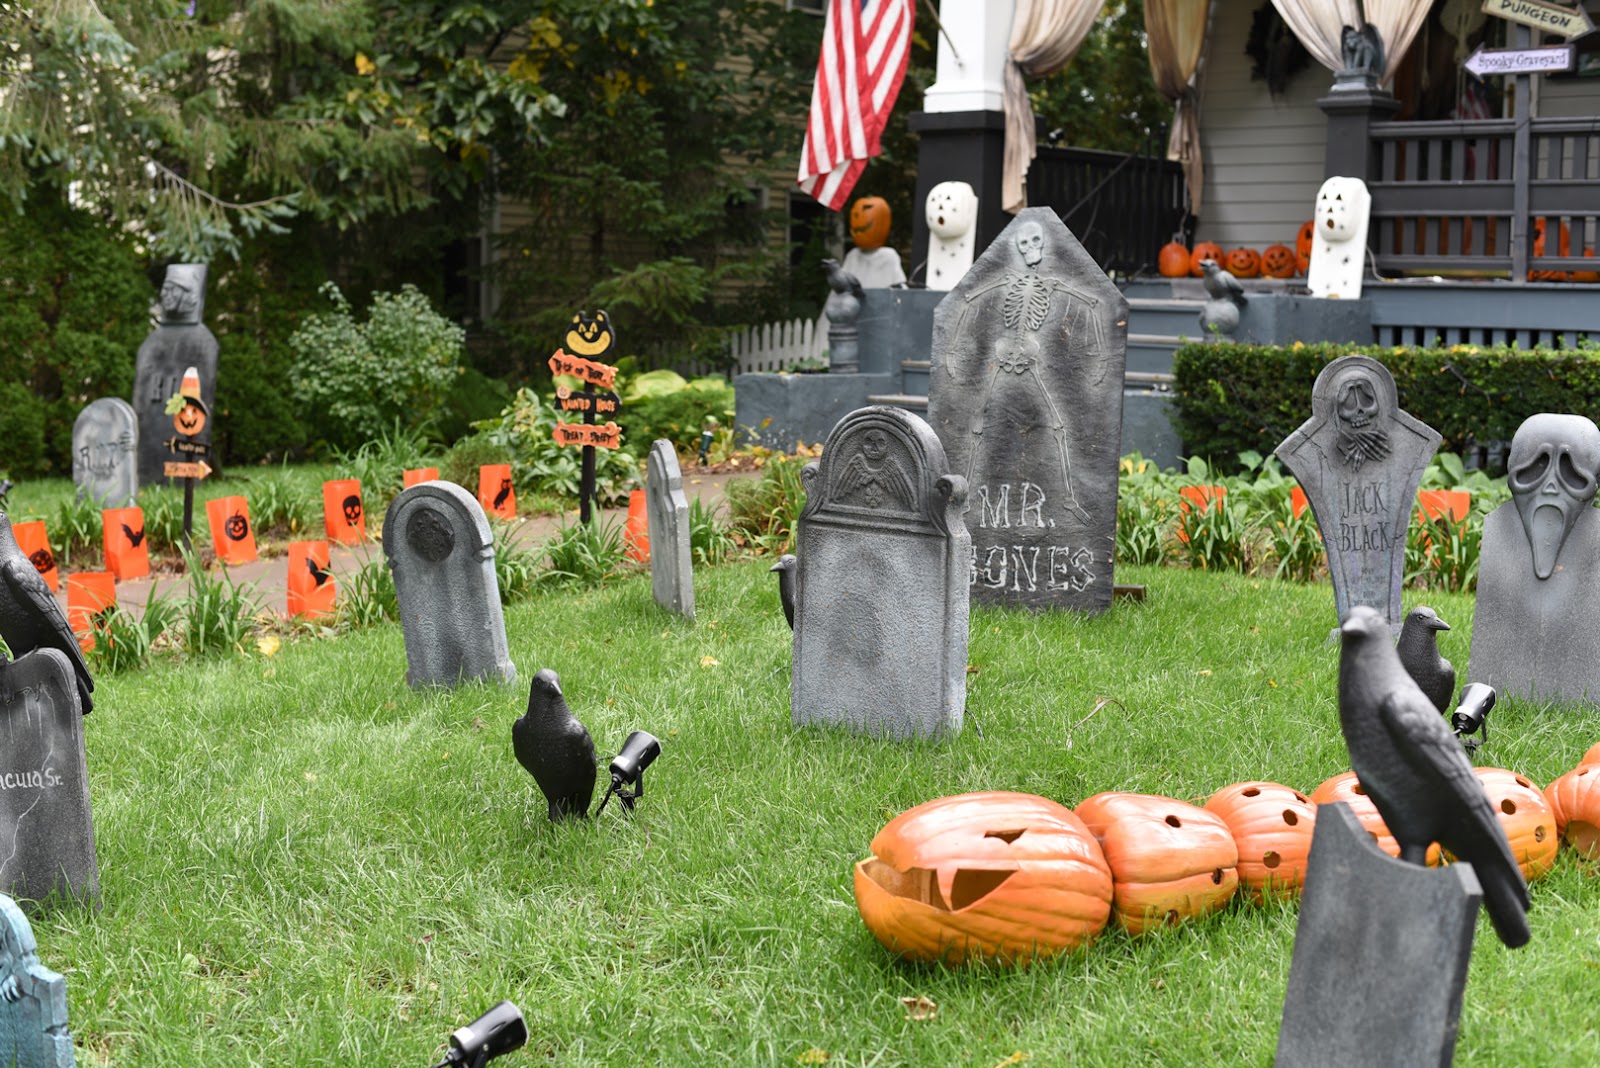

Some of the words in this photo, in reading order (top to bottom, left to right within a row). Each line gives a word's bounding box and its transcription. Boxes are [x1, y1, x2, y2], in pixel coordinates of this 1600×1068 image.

[1501, 0, 1571, 27] DUNGEON
[1478, 54, 1515, 69] Spooky
[1516, 52, 1566, 67] Graveyard
[978, 482, 1055, 528] MR.
[1340, 481, 1388, 520] JACK
[1340, 521, 1392, 552] BLACK
[45, 767, 63, 787] Sr.
